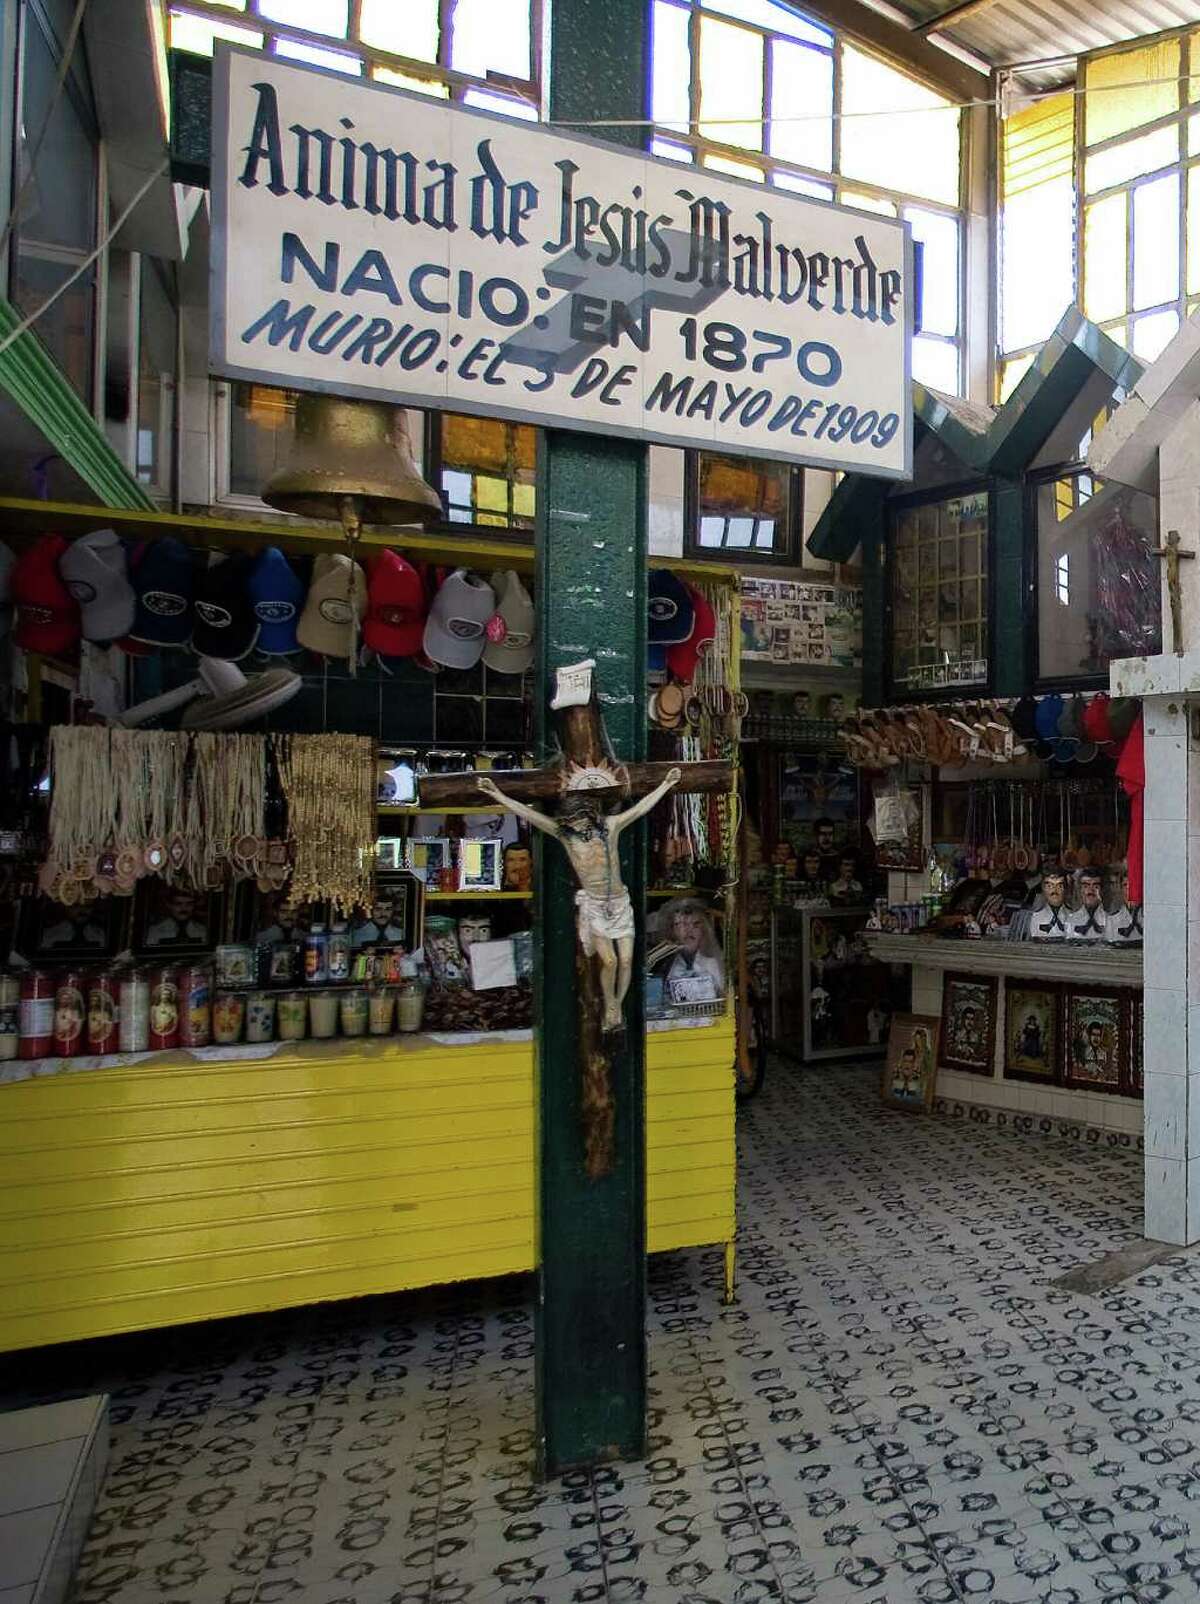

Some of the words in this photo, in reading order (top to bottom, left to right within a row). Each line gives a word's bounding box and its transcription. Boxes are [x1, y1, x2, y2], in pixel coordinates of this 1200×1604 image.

[237, 82, 460, 234] Anima
[470, 139, 541, 249] de
[674, 189, 902, 326] Malverde
[280, 231, 551, 330] NACIO:
[570, 293, 651, 352] EN
[679, 317, 843, 388] 1870
[458, 338, 507, 386] EL
[570, 358, 637, 405] DE
[644, 371, 773, 428] MAYO
